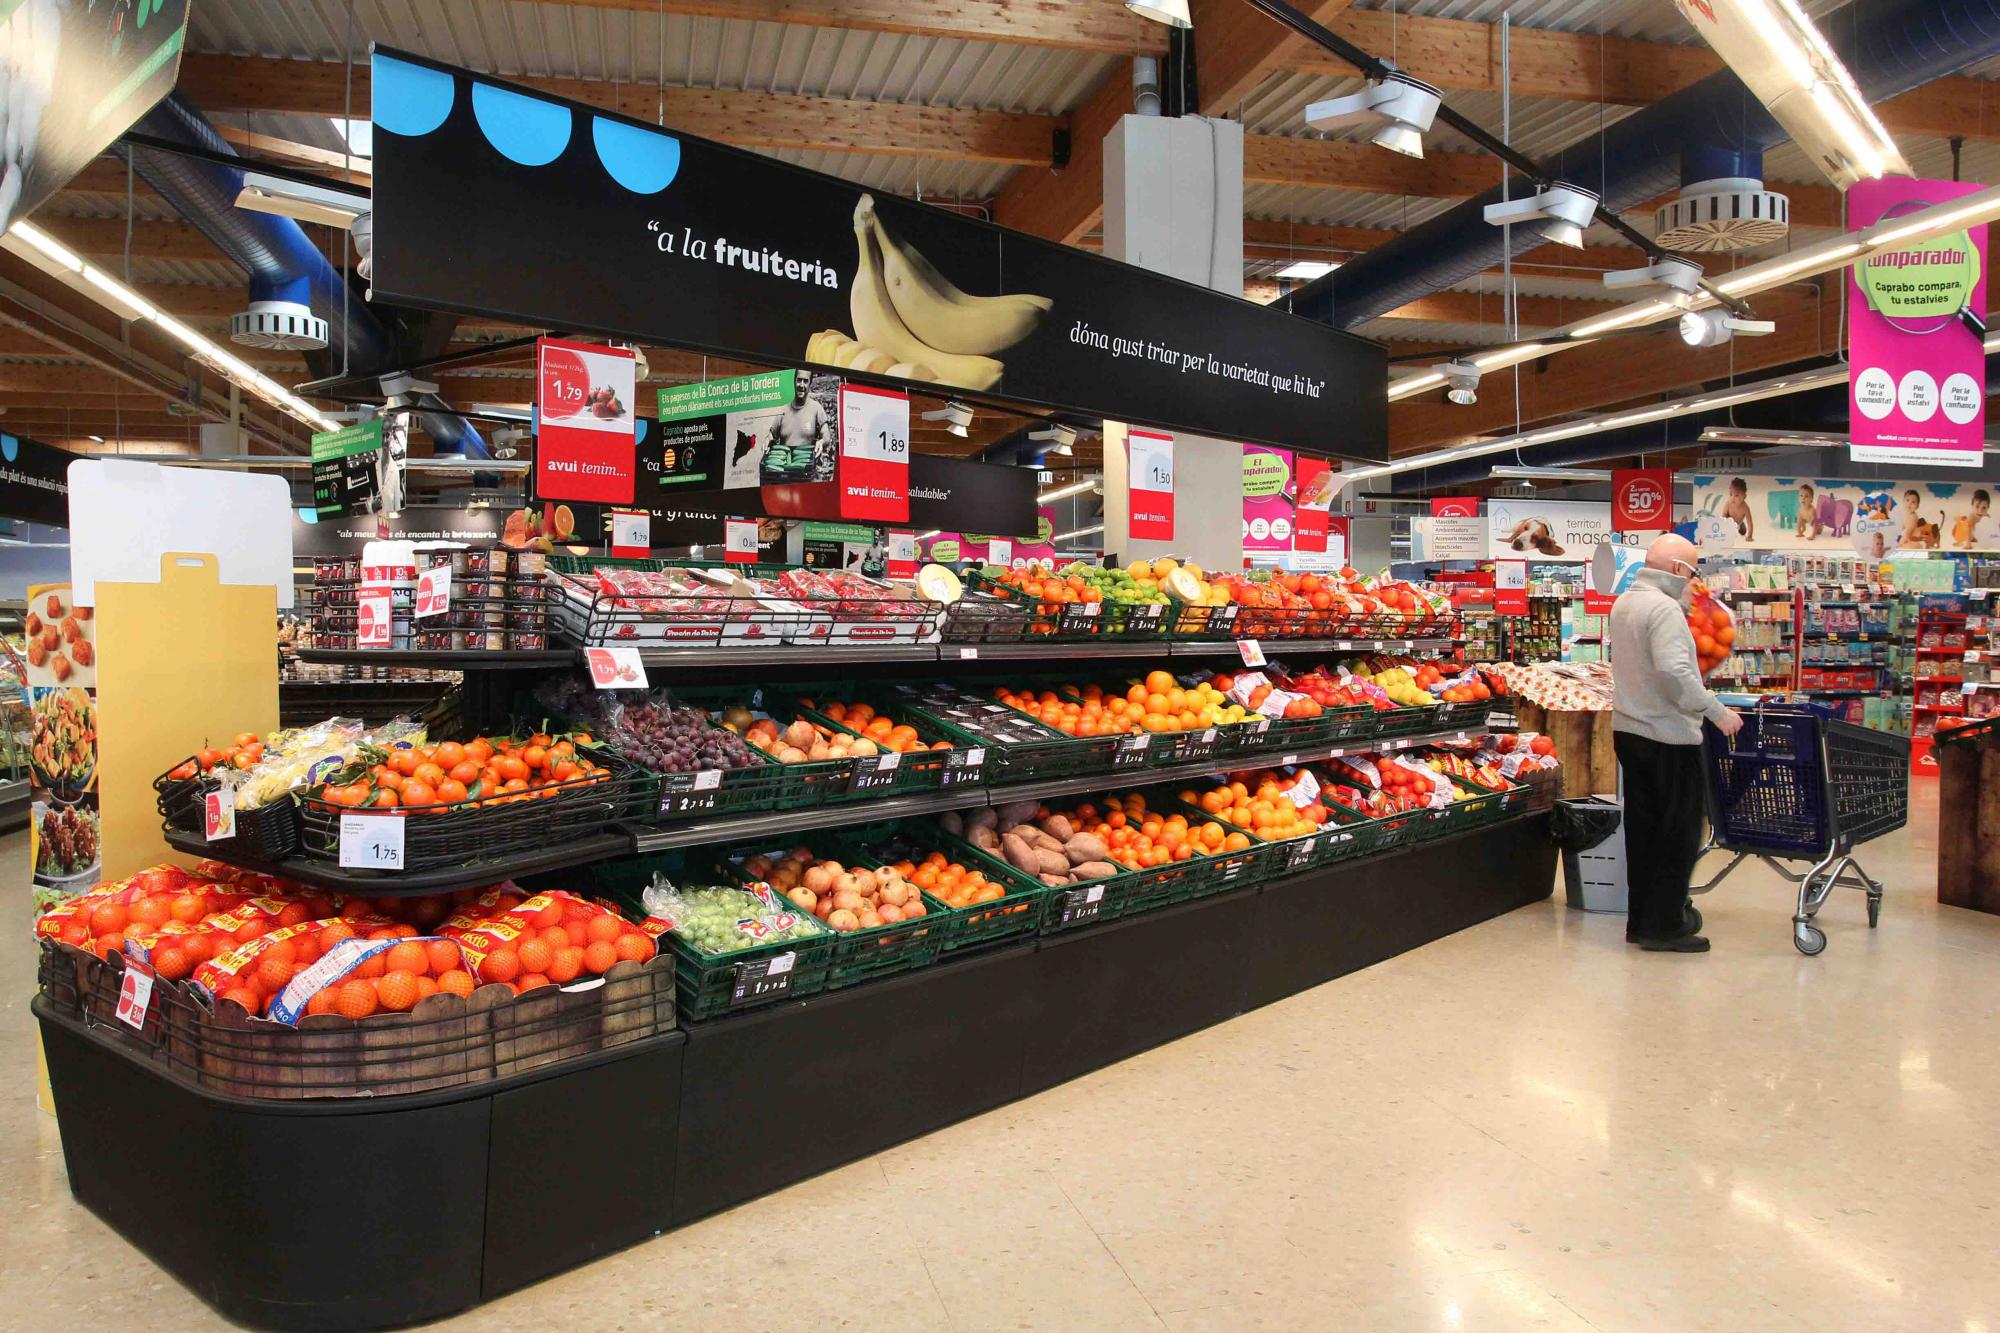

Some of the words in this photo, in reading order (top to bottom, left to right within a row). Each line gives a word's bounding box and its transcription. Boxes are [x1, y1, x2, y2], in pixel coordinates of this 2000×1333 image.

[682, 227, 707, 260] la
[714, 237, 838, 289] fruiteria
[1875, 282, 1915, 293] Caprabo
[1891, 295, 1901, 305] tu
[1904, 295, 1949, 305] estalvies
[1070, 321, 1109, 350] dóna
[1112, 337, 1144, 358] gust
[1147, 342, 1180, 365] triar
[1181, 354, 1205, 373] per
[1207, 353, 1219, 375] la
[1222, 363, 1270, 387] varietat
[1271, 375, 1292, 394] que
[1294, 374, 1305, 394] hi
[553, 380, 583, 401] 1,79
[670, 392, 691, 404] pagesos
[691, 390, 699, 399] de
[700, 387, 706, 398] la
[707, 383, 729, 396] Conca
[730, 381, 740, 393] de
[741, 380, 749, 392] la
[751, 377, 780, 390] Tordera
[722, 398, 734, 407] seus
[734, 394, 761, 407] productes
[879, 431, 905, 453] 1,89
[8, 469, 20, 483] plat
[547, 460, 578, 473] avui
[581, 461, 627, 477] tenim...
[1153, 466, 1171, 485] 1,50
[847, 486, 868, 497] avui
[871, 486, 903, 500] tenim...
[1628, 492, 1662, 509] 50%
[1133, 512, 1148, 520] avui
[372, 843, 397, 861] 1,75
